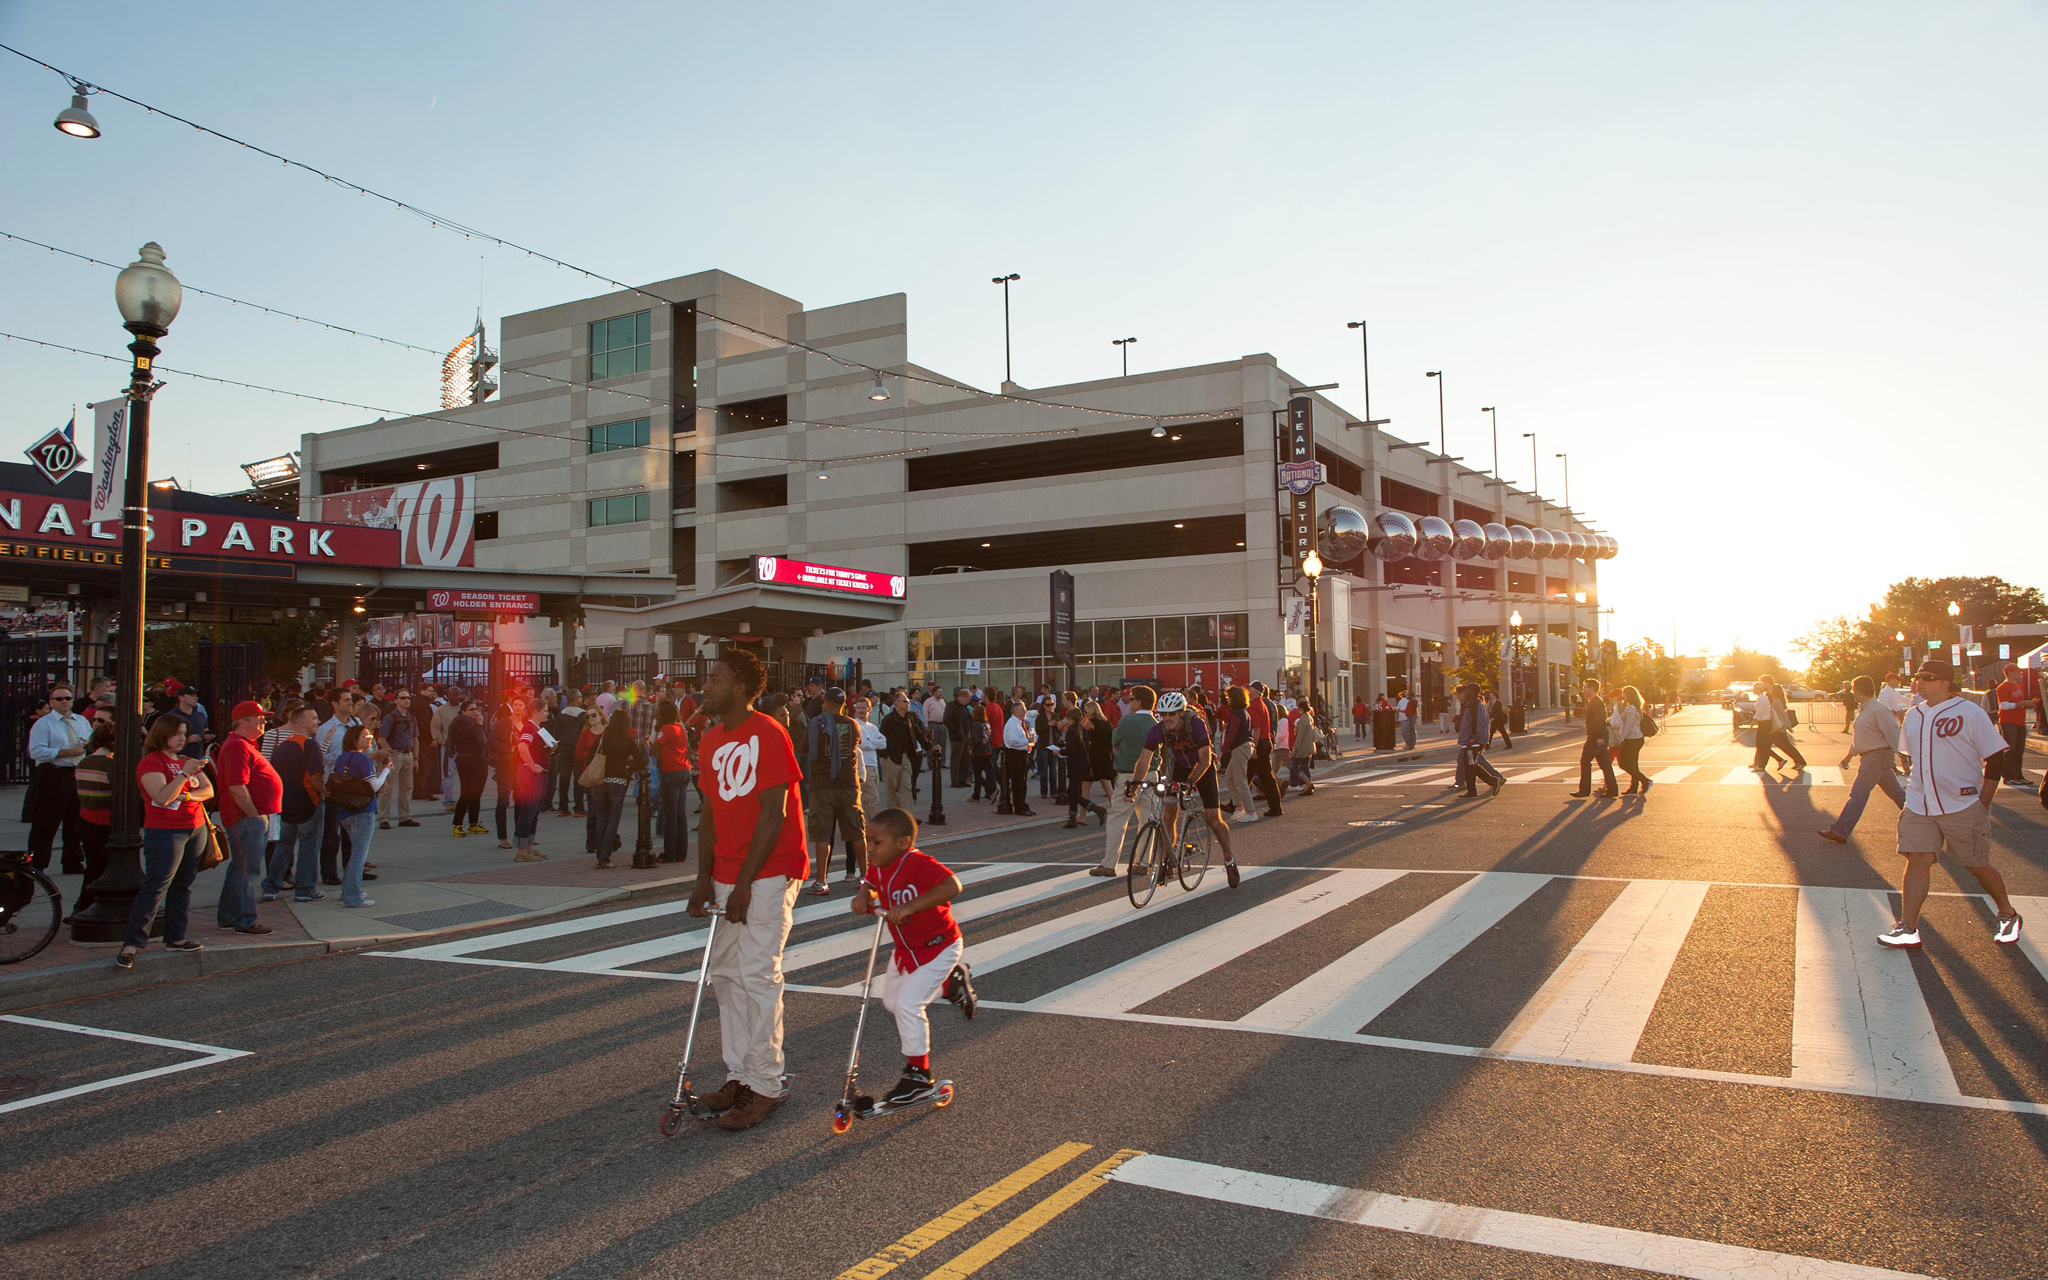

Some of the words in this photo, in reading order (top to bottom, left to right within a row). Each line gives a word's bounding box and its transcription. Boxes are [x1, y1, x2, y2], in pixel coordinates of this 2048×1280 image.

[139, 358, 148, 367] 15
[1295, 410, 1306, 456] TEAM
[41, 441, 77, 472] W
[94, 408, 125, 511] Washington
[1281, 466, 1321, 485] NATIONALS
[181, 518, 337, 558] PARK
[1297, 501, 1308, 560] STORE
[36, 546, 107, 563] FIELD
[113, 554, 173, 569] GTE
[432, 591, 450, 608] W
[461, 592, 495, 600] SEASON
[490, 601, 534, 609] ENTRANCE
[1934, 715, 1964, 738] W
[712, 735, 760, 801] W
